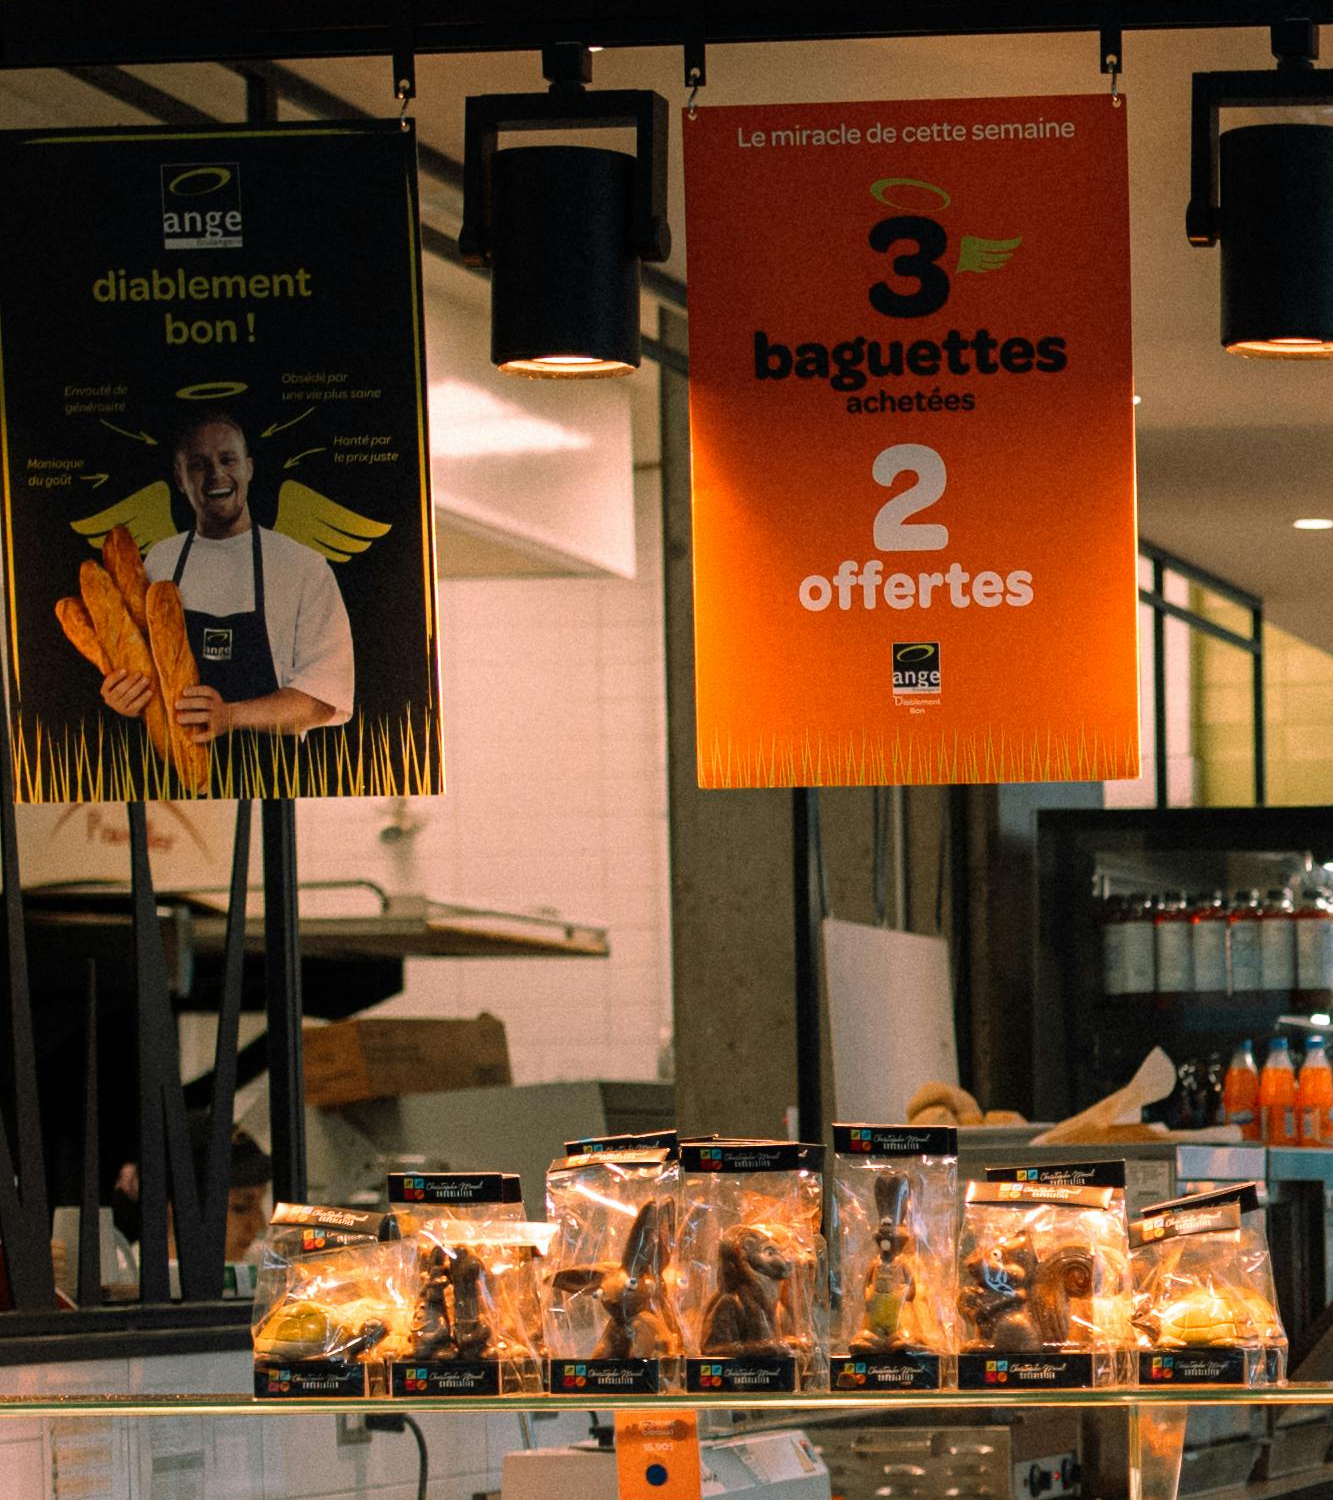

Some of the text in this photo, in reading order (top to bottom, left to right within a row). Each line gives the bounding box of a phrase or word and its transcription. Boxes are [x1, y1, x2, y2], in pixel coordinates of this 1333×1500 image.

[737, 117, 1076, 147] Le miracle de cette semaine
[163, 210, 242, 238] ange
[868, 215, 951, 319] 3
[92, 268, 312, 302] diablement
[165, 313, 237, 344] bon
[754, 329, 1067, 392] baguettes
[324, 389, 349, 401] plus
[351, 389, 382, 398] saine
[846, 386, 976, 415] achetées
[334, 434, 391, 447] Hanté par
[369, 451, 399, 464] juste
[872, 443, 948, 552] 2
[799, 558, 1034, 612] offertes
[893, 670, 941, 688] ange
